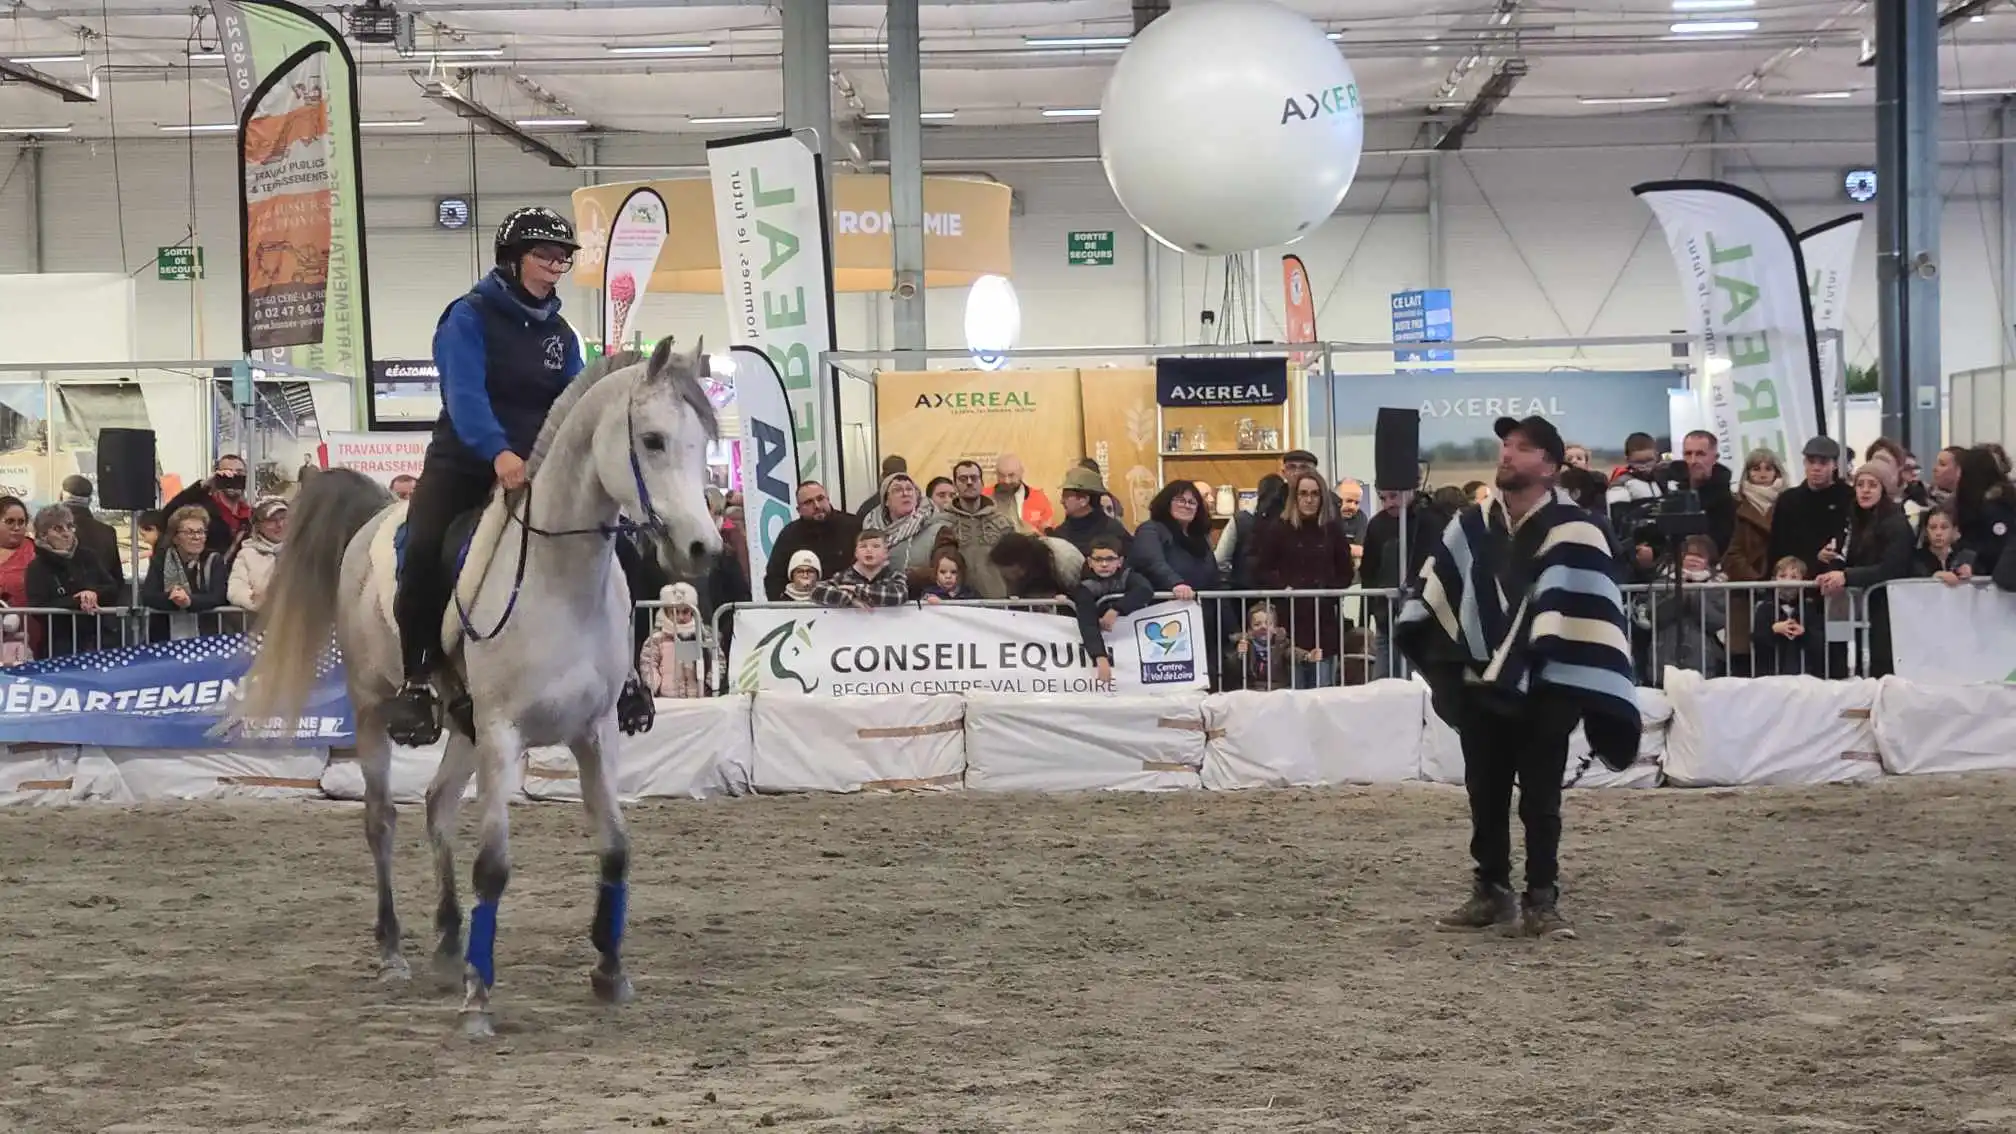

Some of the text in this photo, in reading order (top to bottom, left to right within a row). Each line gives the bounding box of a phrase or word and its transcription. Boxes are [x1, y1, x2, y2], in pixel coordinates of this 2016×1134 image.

[1070, 250, 1113, 259] SECOURS
[1084, 242, 1097, 250] DE
[914, 391, 1036, 409] AXEREAL
[1170, 383, 1274, 401] AXEREAL
[1420, 396, 1566, 418] AXEREAL
[830, 643, 987, 674] CONSEIL
[1032, 678, 1057, 693] DE
[1063, 678, 1117, 693] LOIRE
